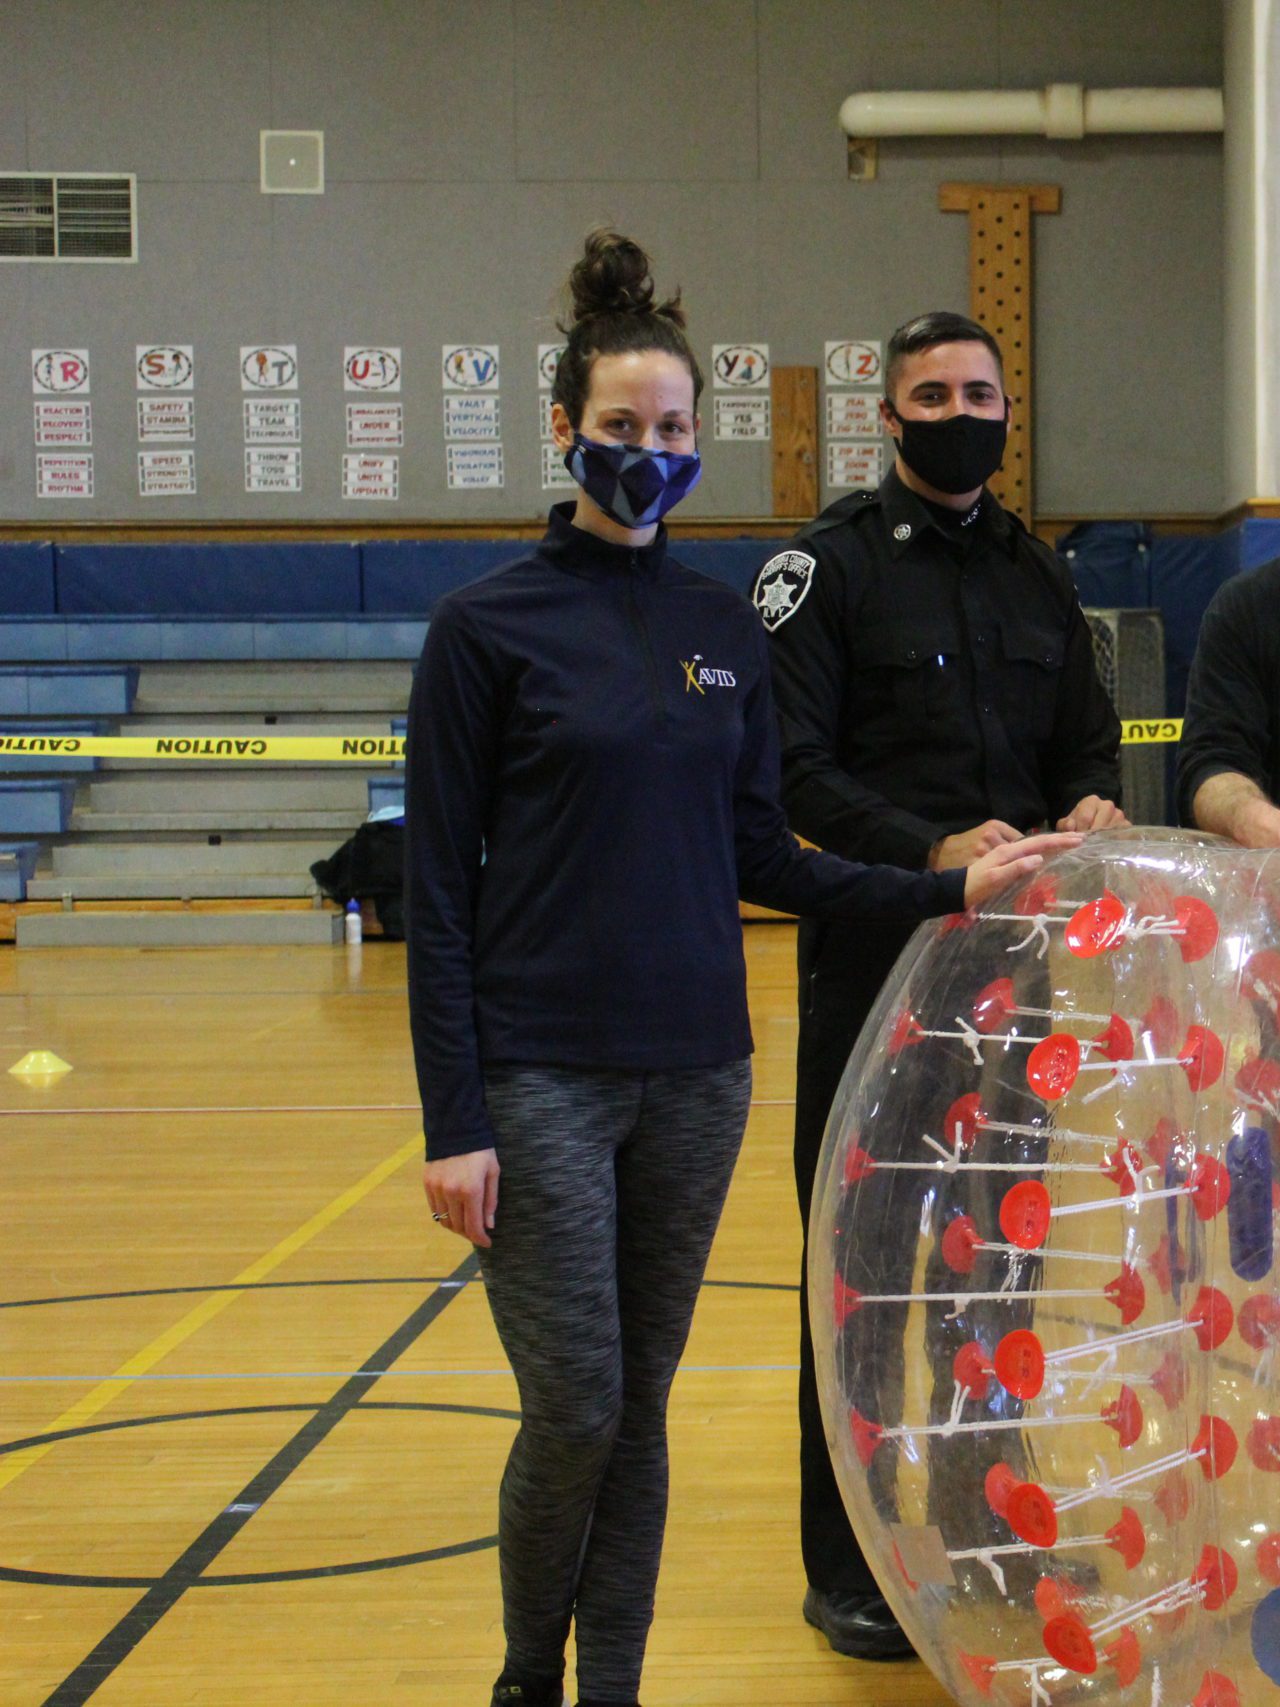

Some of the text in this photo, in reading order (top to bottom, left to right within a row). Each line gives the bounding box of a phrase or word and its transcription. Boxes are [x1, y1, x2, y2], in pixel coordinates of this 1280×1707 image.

[145, 354, 165, 376] S
[351, 359, 370, 380] U
[723, 354, 739, 377] Y
[856, 355, 873, 375] Z
[60, 361, 80, 382] R
[271, 361, 289, 385] T
[472, 359, 491, 382] V
[149, 403, 184, 412] SAFETY
[253, 404, 290, 413] TARGET
[458, 400, 486, 409] VAULT
[146, 415, 187, 424] STAMINA
[259, 417, 286, 426] TEAM
[451, 413, 493, 422] VERTICAL
[452, 427, 494, 436] VELOCITY
[44, 433, 84, 441] RESPECT
[151, 456, 183, 465] SPEED
[51, 472, 80, 480] RULES
[352, 486, 390, 496] UPDATE
[699, 668, 736, 687] AVID
[156, 739, 267, 755] CAUTION
